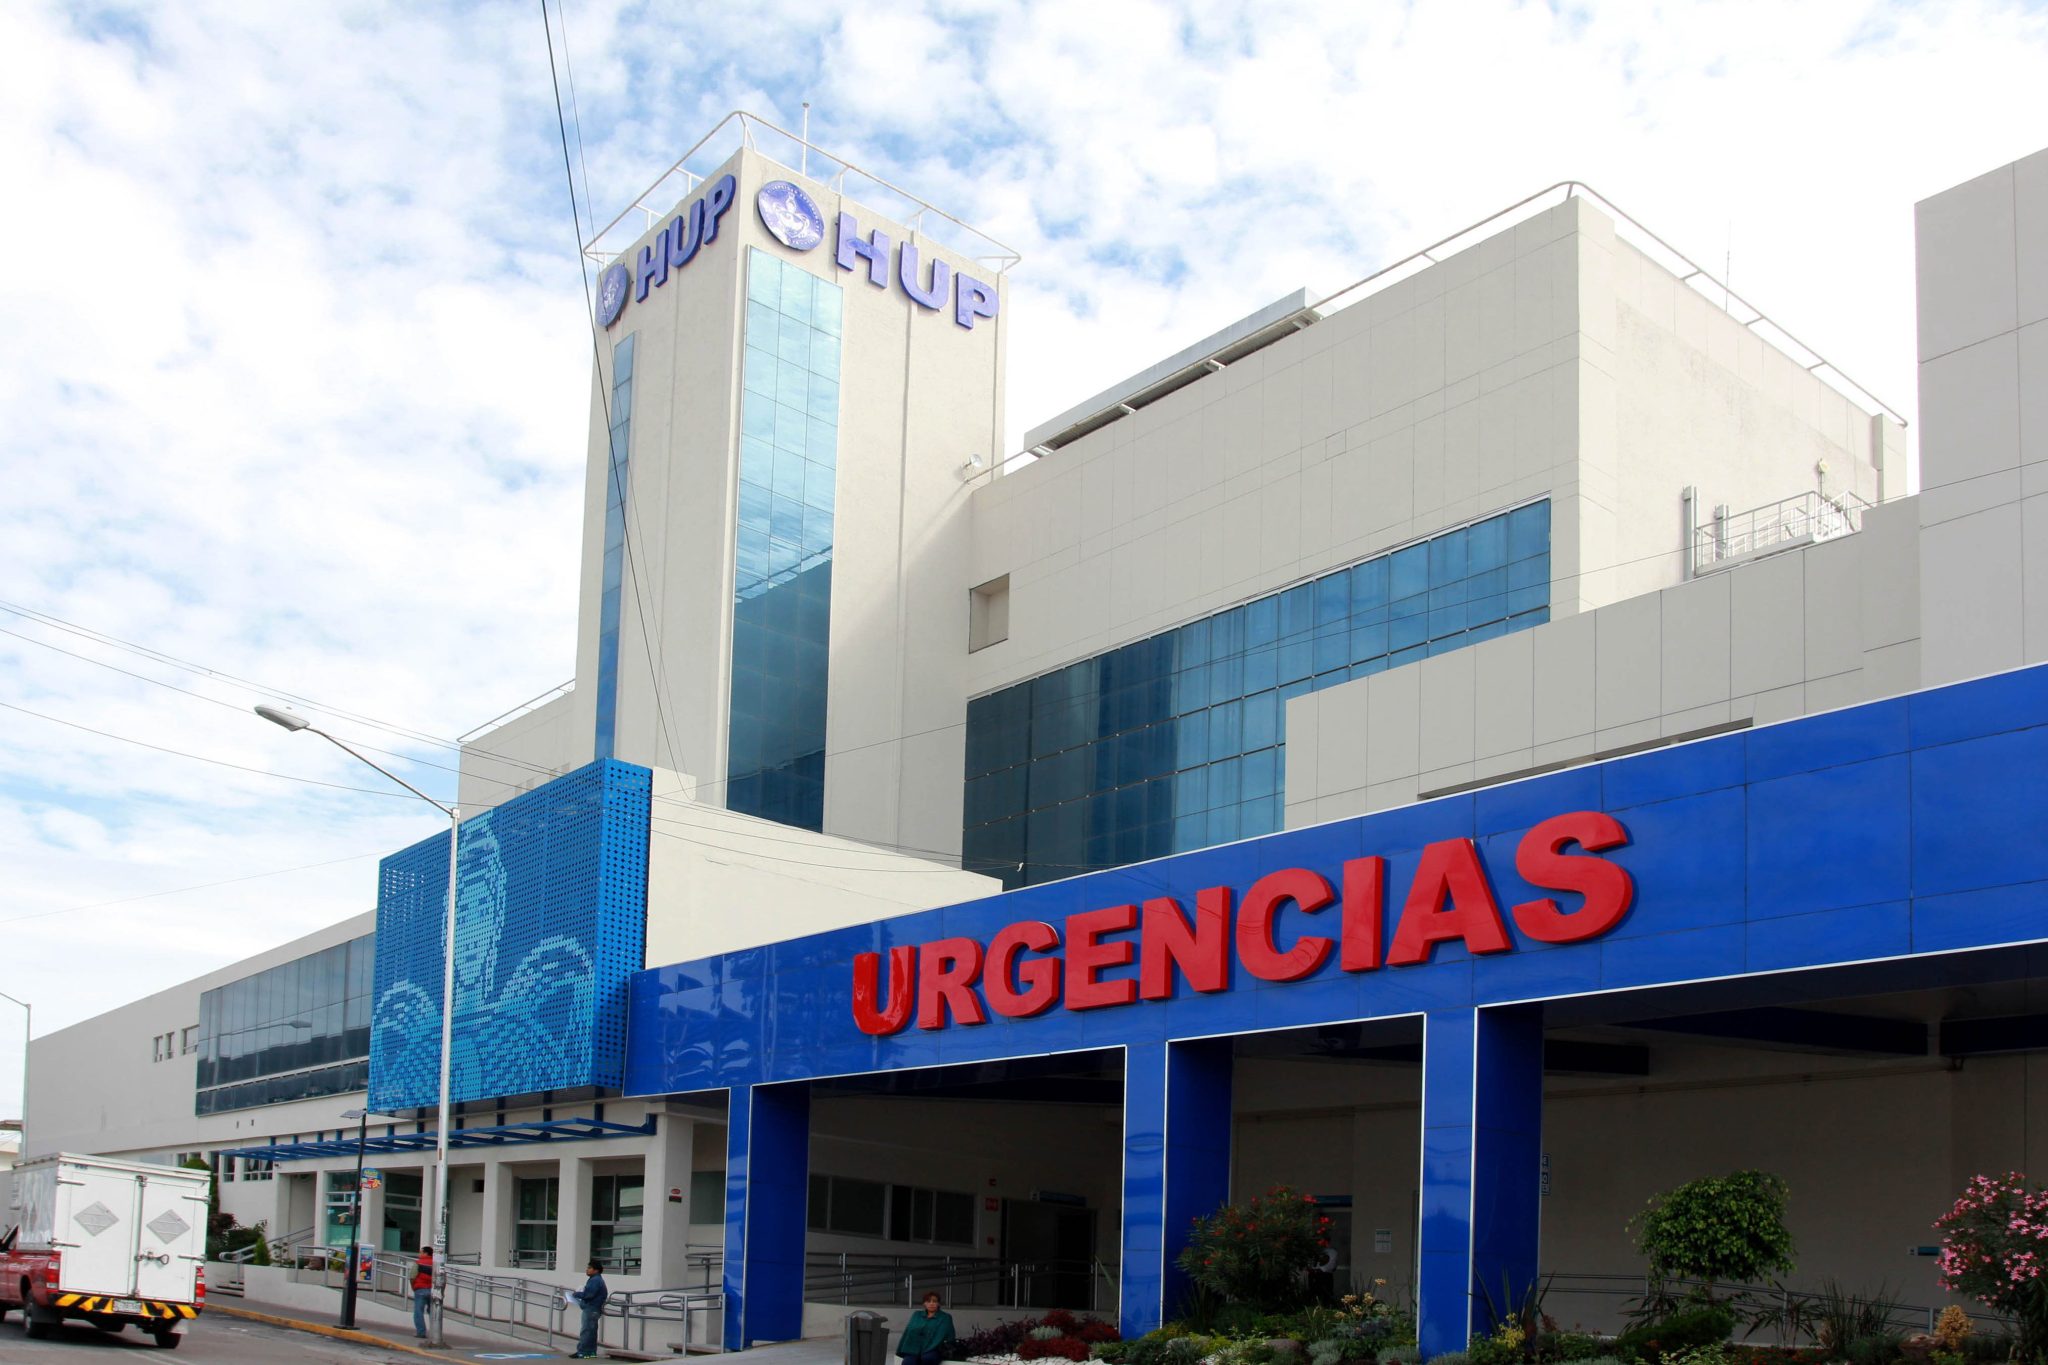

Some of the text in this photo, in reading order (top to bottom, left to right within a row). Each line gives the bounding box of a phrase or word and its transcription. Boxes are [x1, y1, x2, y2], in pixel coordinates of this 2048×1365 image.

[635, 174, 737, 303] HUP
[834, 211, 1001, 331] HUP
[851, 811, 1634, 1036] URGENCIAS
